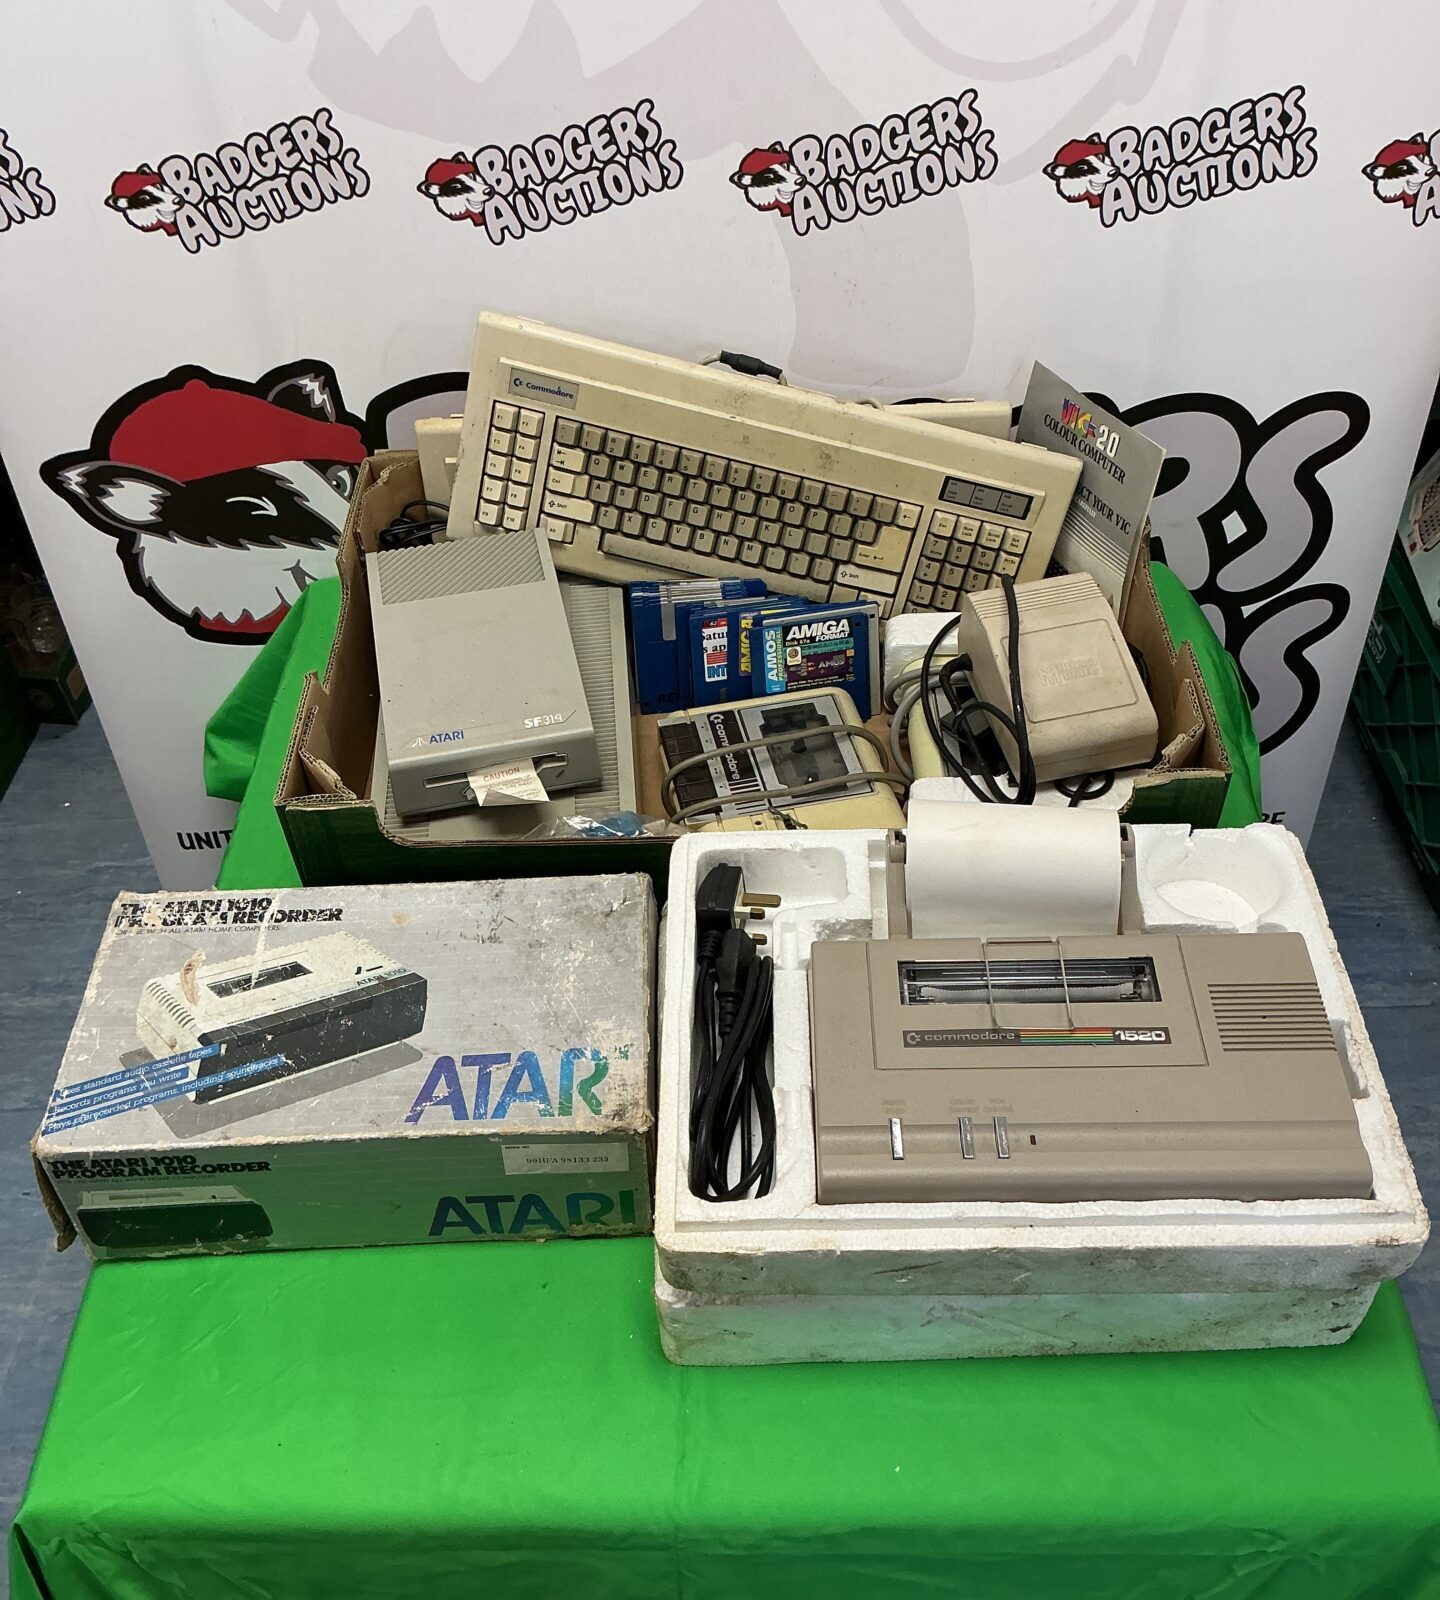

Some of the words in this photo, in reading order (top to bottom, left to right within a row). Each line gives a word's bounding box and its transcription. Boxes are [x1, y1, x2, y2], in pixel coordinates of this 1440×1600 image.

[471, 98, 659, 200] BADGERS
[790, 88, 979, 187] BADGERS
[1108, 85, 1306, 179] BADGERS
[157, 108, 342, 203] BADGERS
[482, 139, 684, 246] AUCTIONS
[792, 128, 999, 236] AUCTIONS
[1100, 126, 1317, 228] AUCTIONS
[174, 147, 370, 254] AUCTIONS
[526, 382, 574, 399] Commodore
[1044, 413, 1077, 449] COLOUR
[1078, 439, 1126, 484] COMPUTER
[1061, 397, 1121, 458] VIC-20
[1092, 491, 1114, 524] YOUR
[1116, 513, 1131, 535] VIC
[786, 619, 850, 640] AMIGA
[815, 632, 848, 642] FORMAT
[707, 666, 726, 678] INT
[765, 630, 778, 681] AMOS
[776, 631, 784, 681] PROFESSIONAL
[818, 660, 845, 669] AMOS
[429, 730, 464, 744] ATARI
[524, 713, 562, 729] SF314
[483, 766, 520, 782] CAUTION
[176, 829, 233, 850] UNIT
[162, 899, 222, 913] ATARI
[227, 898, 273, 911] 1010
[357, 975, 384, 986] ATARI
[384, 969, 406, 977] 1010
[925, 1030, 1015, 1042] commodore
[1115, 1030, 1165, 1042] 1520
[83, 1072, 122, 1090] standard
[125, 1064, 150, 1079] audio
[152, 1054, 186, 1070] cassette
[188, 1048, 214, 1060] tapes.
[93, 1085, 137, 1105] programs
[139, 1078, 156, 1091] you
[158, 1071, 182, 1082] write
[47, 1120, 72, 1132] Plays
[133, 1088, 179, 1108] programs,
[182, 1073, 224, 1091] including
[226, 1057, 279, 1079] soundtracks
[51, 1159, 86, 1170] THE
[91, 1157, 149, 1169] ATARI
[151, 1155, 197, 1167] 1010
[52, 1166, 162, 1179] PROGRAM
[164, 1161, 272, 1175] RECORDER
[429, 1189, 636, 1236] ATARI
